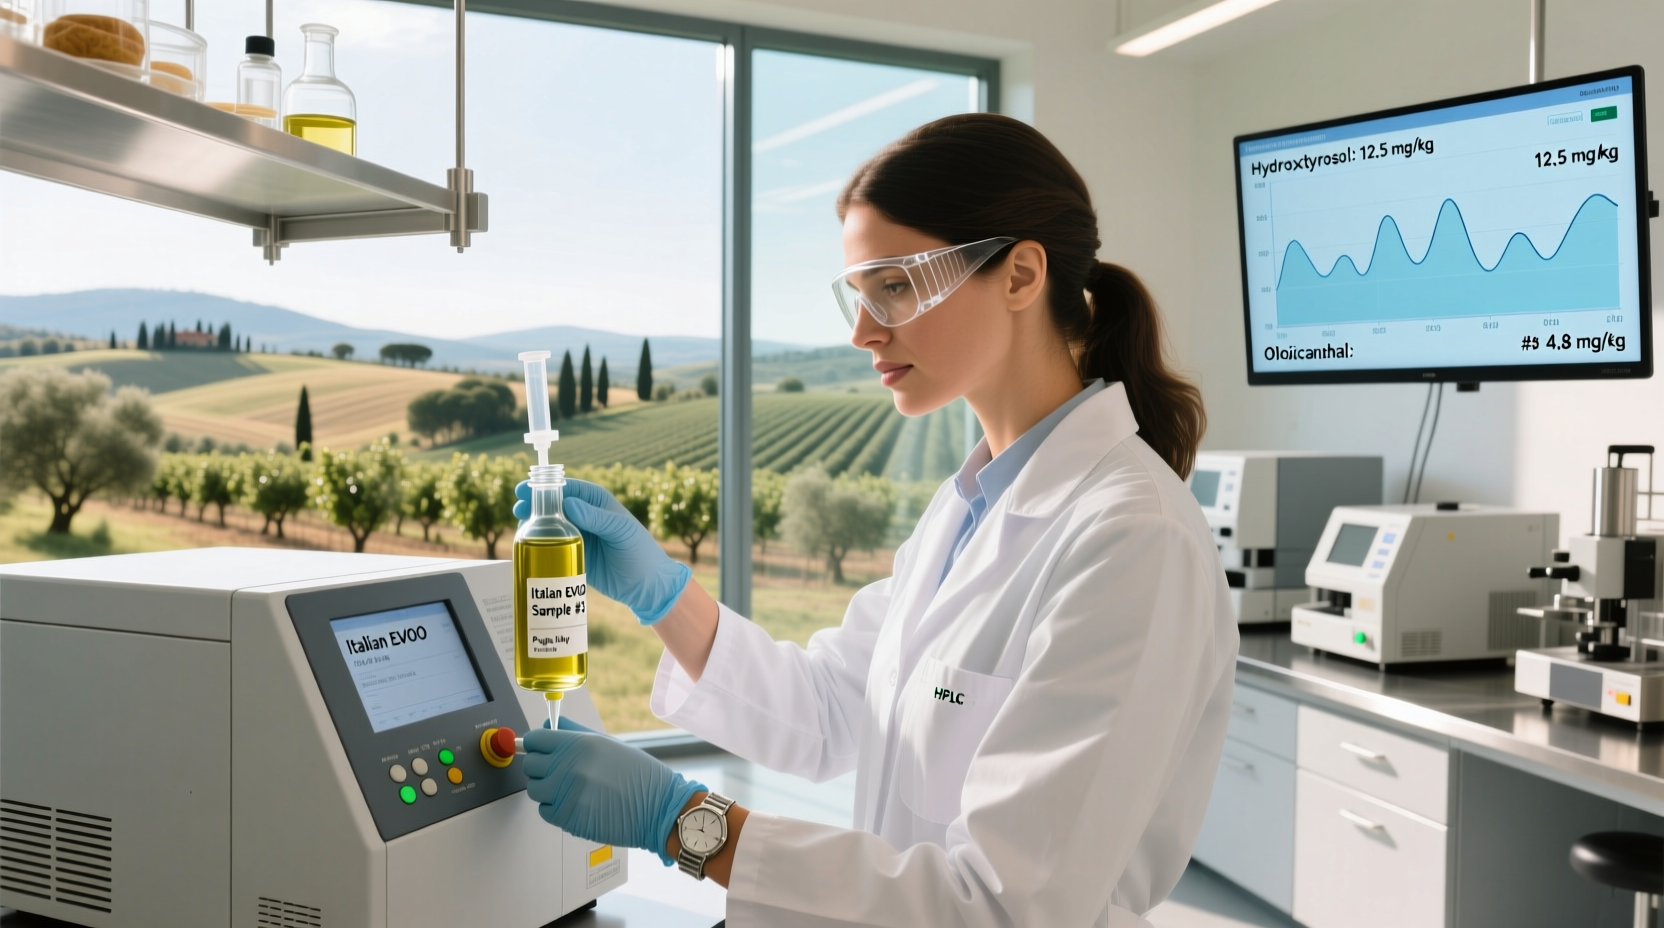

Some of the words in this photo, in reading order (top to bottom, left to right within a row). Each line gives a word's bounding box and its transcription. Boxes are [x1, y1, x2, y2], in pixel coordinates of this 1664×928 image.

[1359, 142, 1388, 161] 12.5
[1391, 137, 1434, 158] mg/kg
[1535, 149, 1567, 168] 12.5
[1546, 333, 1572, 350] 4.8
[1576, 331, 1626, 353] mg/kg
[531, 603, 571, 619] Sample
[346, 635, 388, 655] Italian
[389, 625, 427, 646] EVOO
